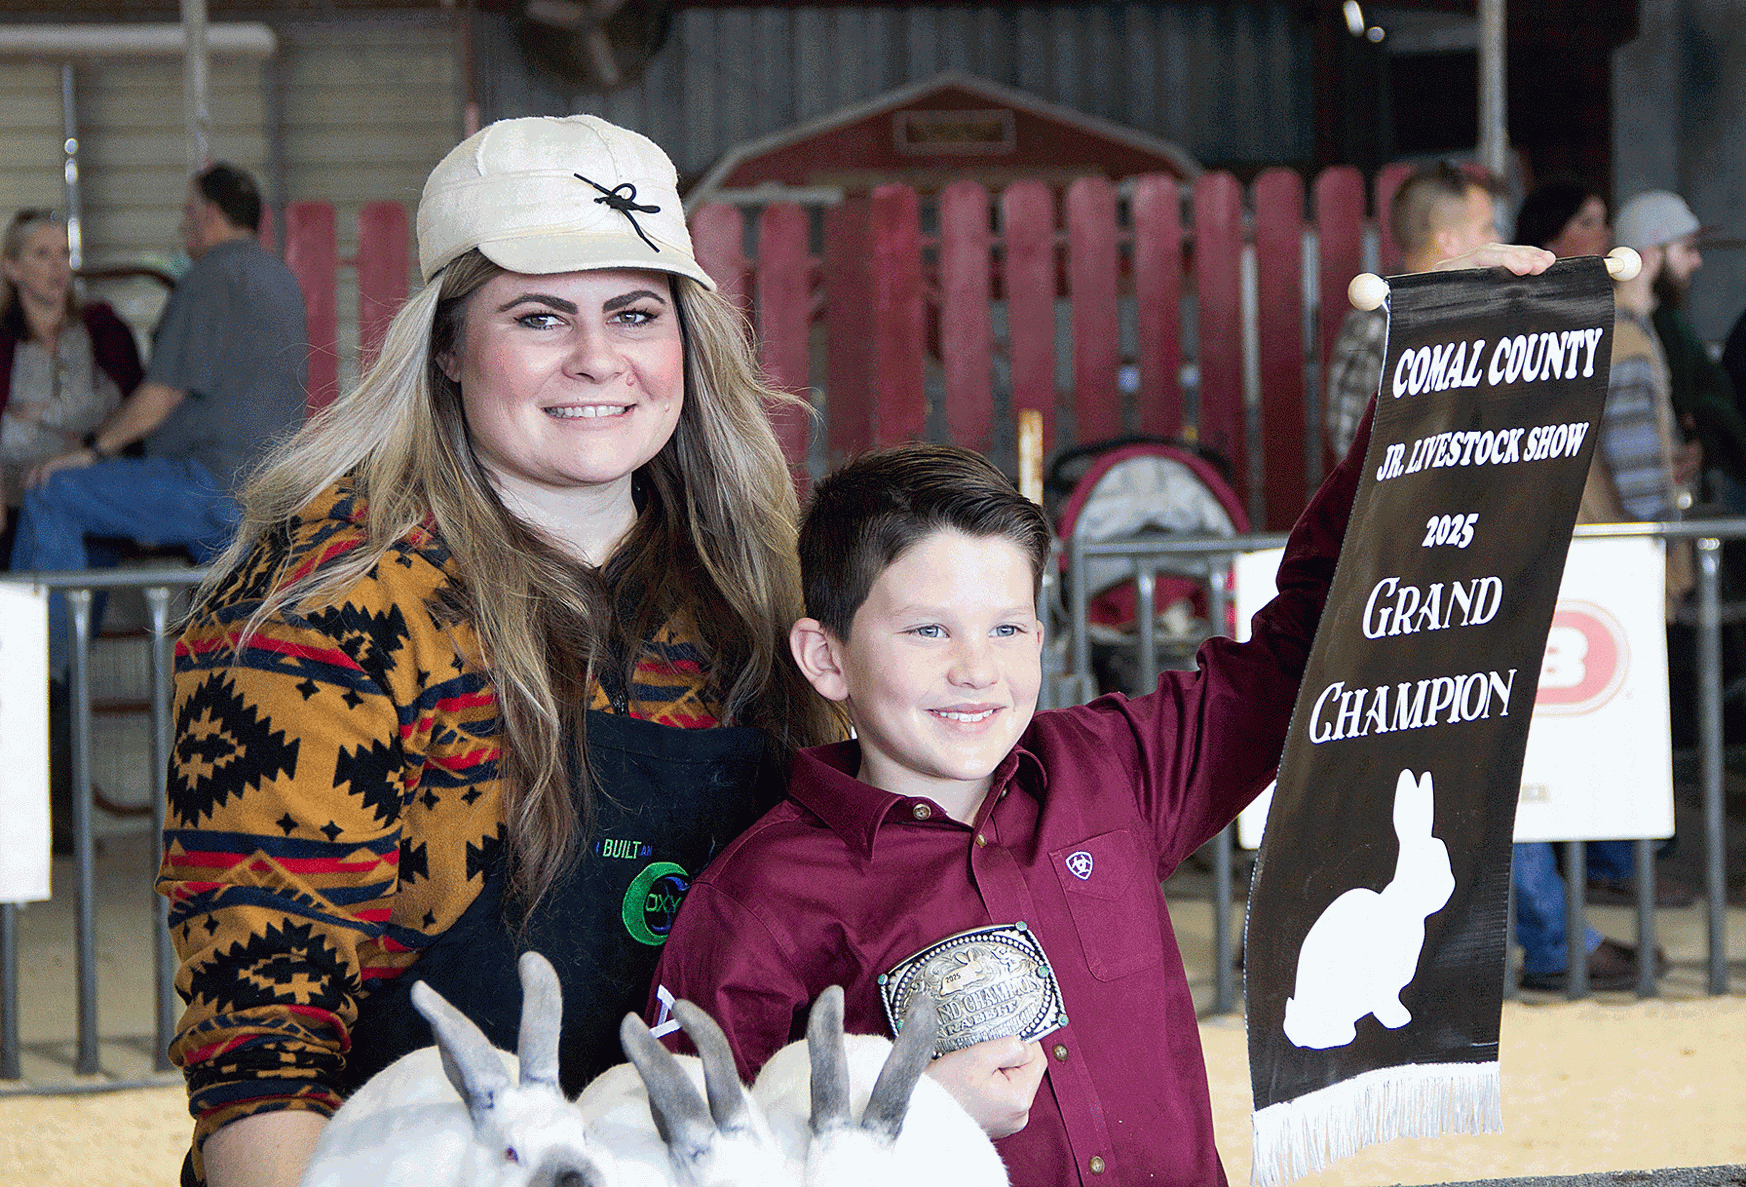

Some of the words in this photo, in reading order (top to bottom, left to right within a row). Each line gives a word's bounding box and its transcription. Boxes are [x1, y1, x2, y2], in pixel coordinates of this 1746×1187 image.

[1392, 339, 1486, 399] COMAL
[1487, 327, 1603, 386] COUNTY
[1376, 443, 1405, 482] JR.
[1405, 427, 1524, 475] LIVESTOCK
[1523, 421, 1590, 462] SHOW
[1421, 513, 1479, 549] 2025
[1362, 576, 1503, 640] GRAND
[1309, 668, 1518, 745] CHAMPION
[602, 838, 642, 860] BUILT
[944, 972, 962, 984] 2025
[962, 973, 1042, 1014] CHAMPION
[945, 1000, 1018, 1036] RABBIT
